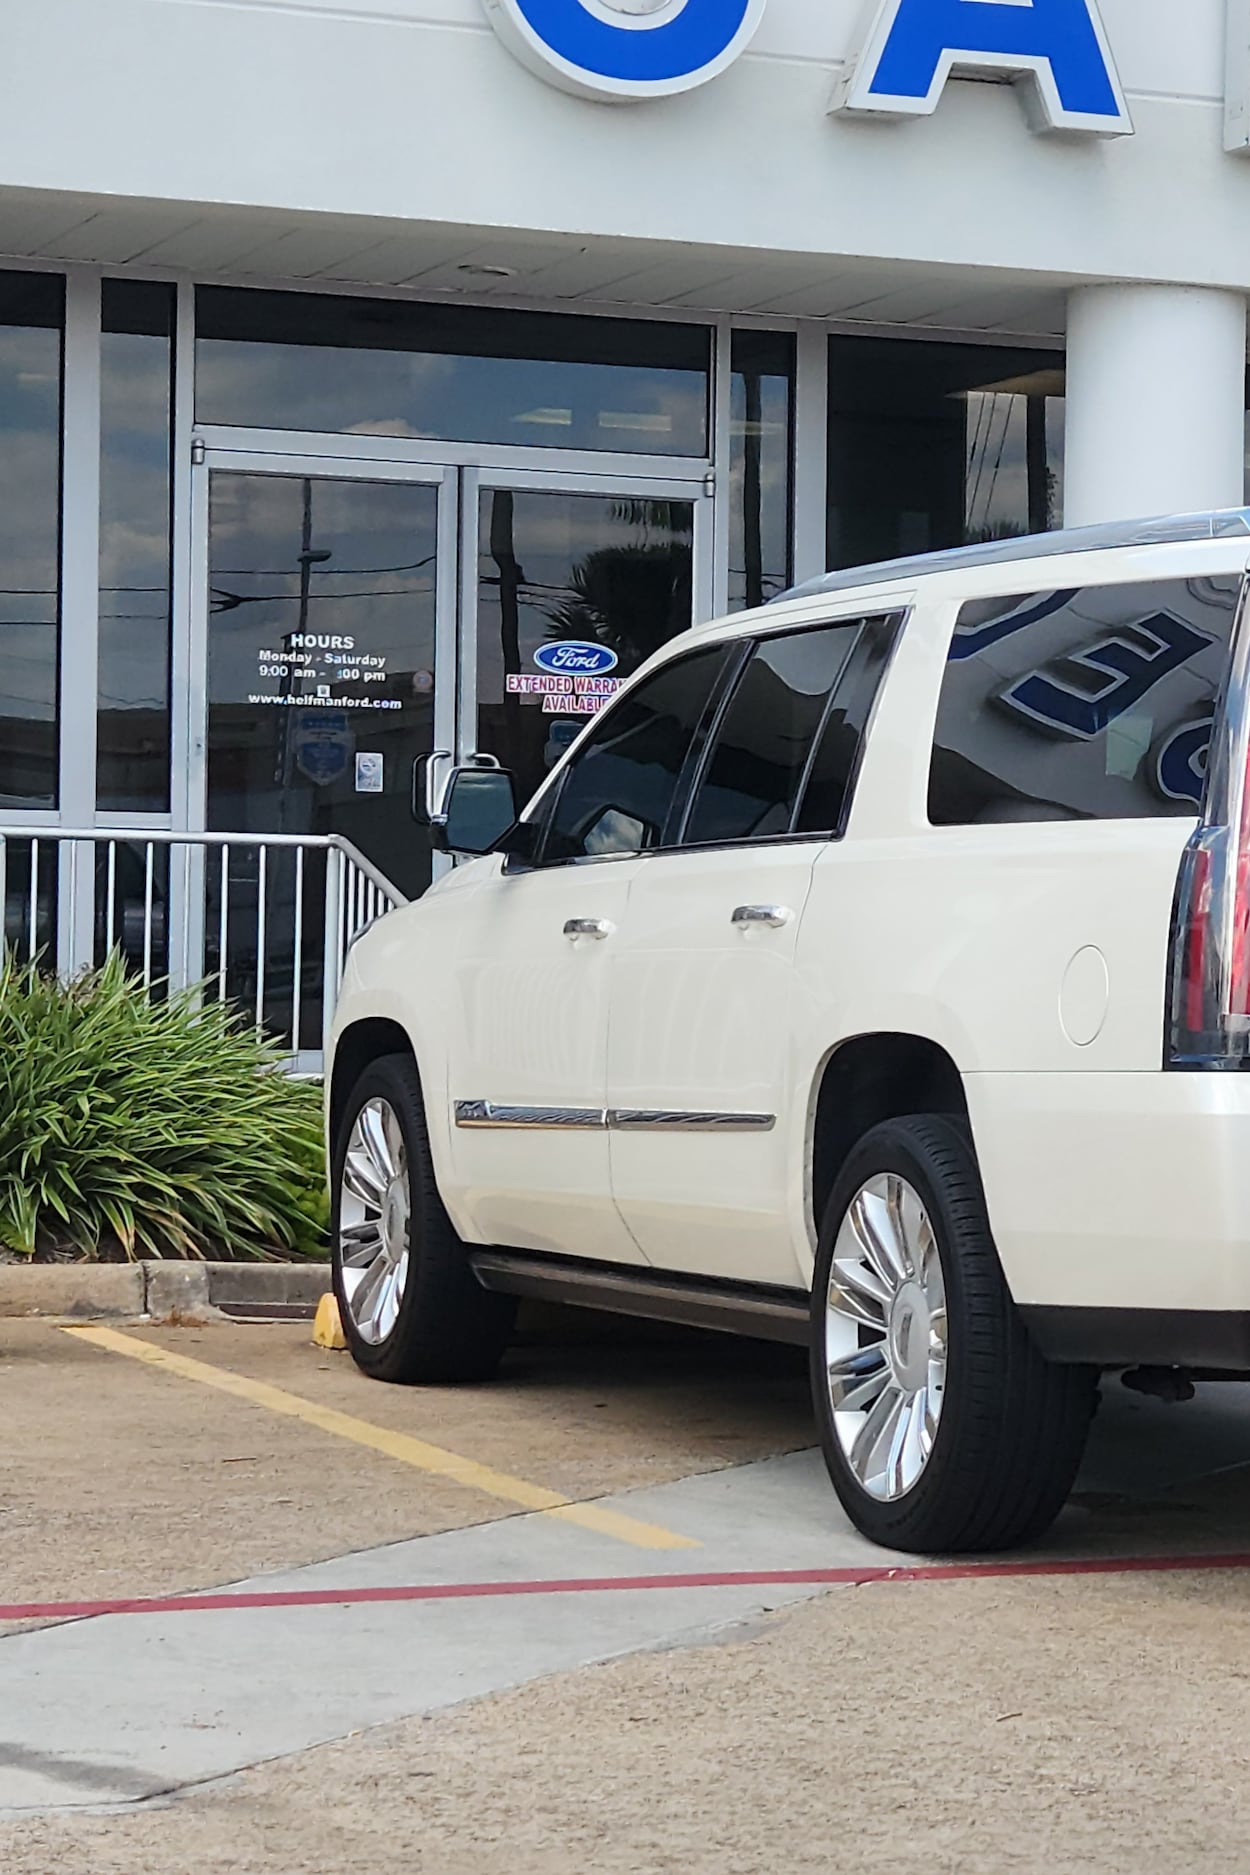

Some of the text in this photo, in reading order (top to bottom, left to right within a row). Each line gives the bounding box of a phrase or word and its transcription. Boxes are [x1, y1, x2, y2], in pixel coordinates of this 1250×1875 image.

[290, 633, 355, 650] HOURS
[258, 649, 313, 665] Monday
[324, 652, 386, 668] Saturday
[551, 646, 601, 669] Ford
[259, 665, 289, 677] 9:00
[294, 669, 317, 678] am
[363, 671, 386, 683] pm
[507, 675, 573, 693] EXTENDED
[248, 693, 402, 710] www.helfmanford.com
